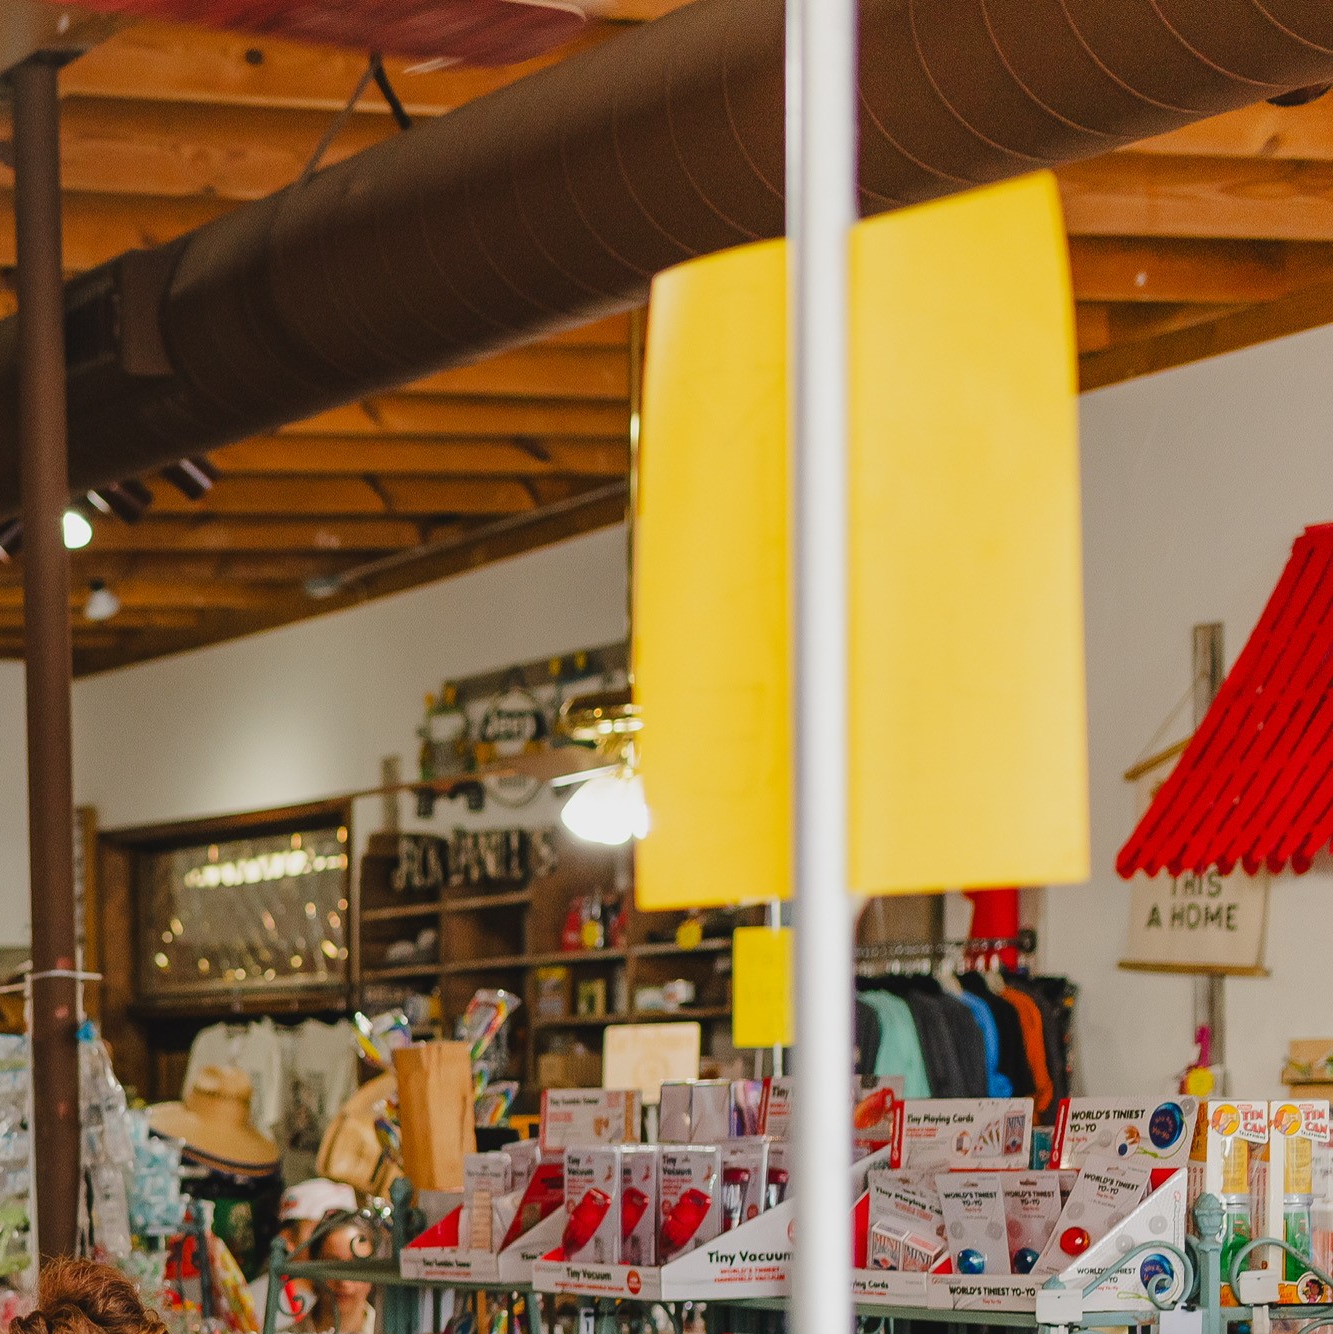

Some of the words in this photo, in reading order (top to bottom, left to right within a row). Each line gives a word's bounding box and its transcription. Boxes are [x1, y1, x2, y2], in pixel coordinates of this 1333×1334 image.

[1146, 903, 1161, 929] A
[1170, 902, 1238, 931] HOME
[906, 1114, 922, 1125] Tiny
[923, 1114, 951, 1125] Playing
[952, 1113, 974, 1123] Cards
[1071, 1110, 1110, 1120] WORLD'S
[1112, 1109, 1146, 1120] TINIEST
[1241, 1109, 1265, 1121] TIN
[1303, 1109, 1326, 1121] TIN
[1069, 1123, 1097, 1133] YO-YO
[1243, 1122, 1267, 1134] CAN
[1305, 1122, 1328, 1134] CAN
[1083, 1173, 1114, 1186] WORLD'S
[1115, 1179, 1140, 1192] TINIEST
[943, 1191, 973, 1199] WORLD'S
[974, 1191, 997, 1199] TINIEST
[1097, 1185, 1119, 1195] YO-YO
[708, 1251, 736, 1266] Tiny
[566, 1267, 580, 1281] Tiny
[582, 1270, 612, 1281] Vacuum
[868, 1280, 889, 1290] Cards
[949, 1285, 982, 1295] WORLD'S
[983, 1286, 1010, 1296] TINIEST
[1012, 1287, 1036, 1297] YO-YO
